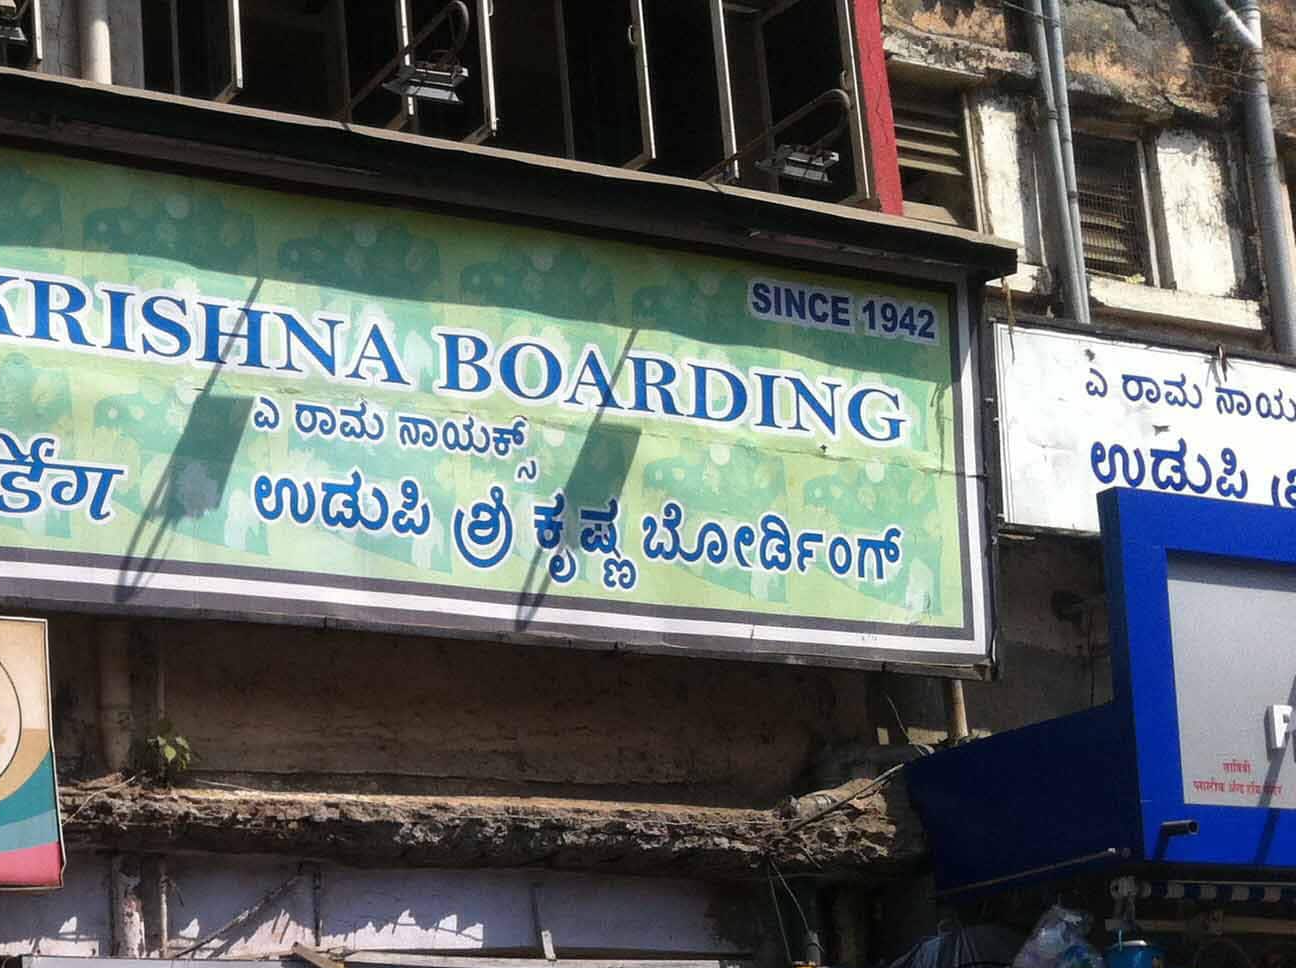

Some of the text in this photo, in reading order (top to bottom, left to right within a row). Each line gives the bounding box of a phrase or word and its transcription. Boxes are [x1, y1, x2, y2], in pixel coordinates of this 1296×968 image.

[751, 282, 937, 340] SINCE 1942
[436, 331, 906, 444] BOARDING
[1121, 373, 1203, 409] ರಾಮ
[294, 400, 384, 441] ರಾಮ
[1090, 437, 1248, 499] ಉಡುಪಿ
[254, 470, 431, 535] ಉಡುಪಿ
